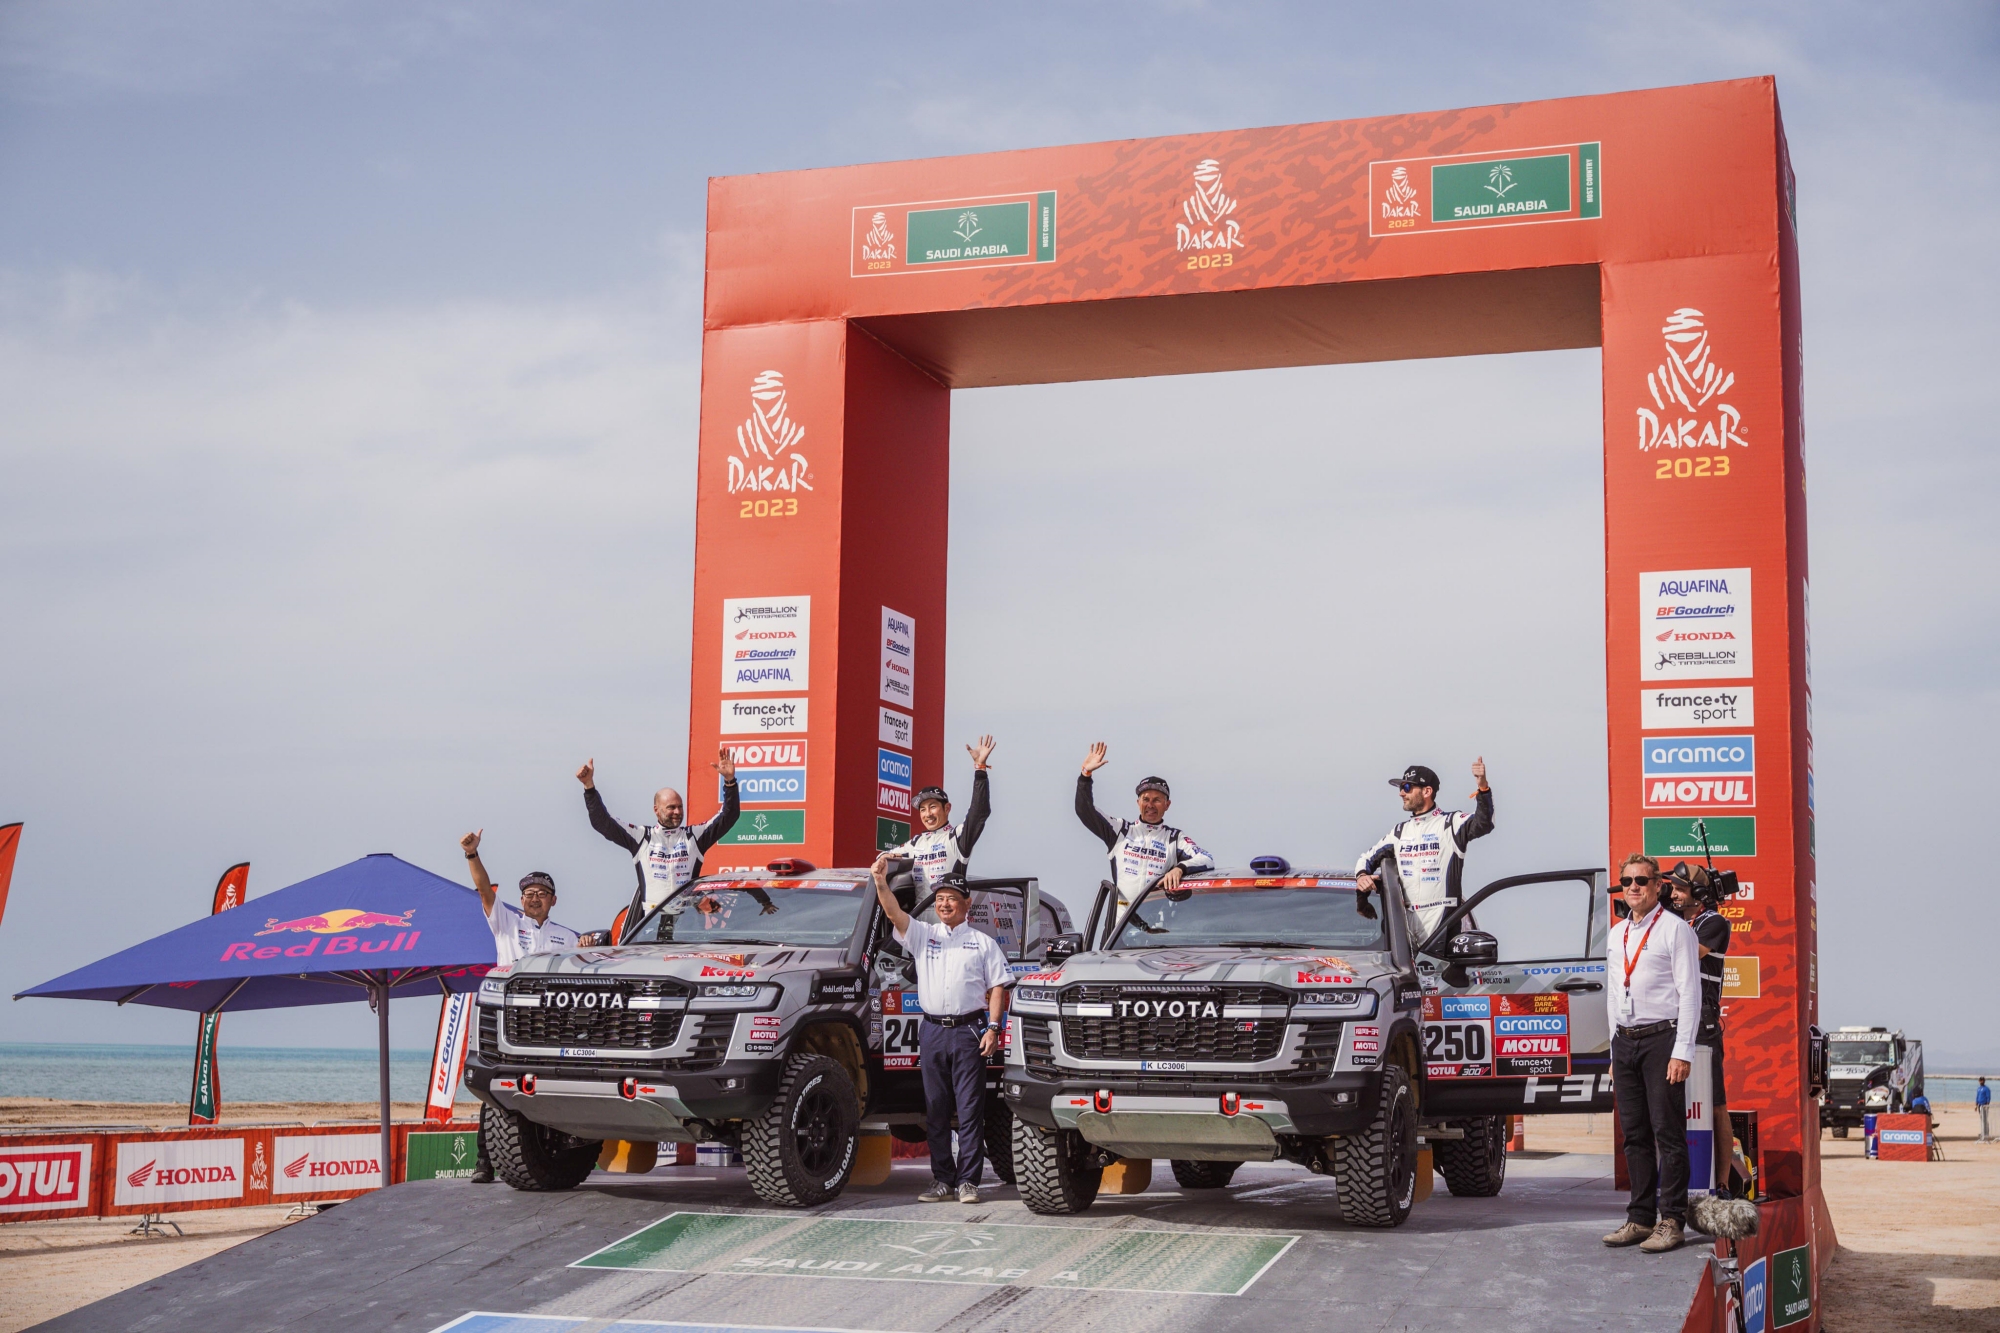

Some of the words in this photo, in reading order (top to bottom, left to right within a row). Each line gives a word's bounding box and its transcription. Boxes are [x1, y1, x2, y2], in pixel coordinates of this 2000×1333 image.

[1382, 200, 1421, 219] DAKAR
[1454, 204, 1493, 217] SAUDI
[1497, 200, 1548, 213] ARABIA
[1388, 219, 1415, 228] 2023
[1176, 220, 1244, 252] DAKAR
[862, 243, 897, 260] DAKAR
[926, 248, 961, 260] SAUDI
[965, 244, 1008, 256] ARABIA
[867, 261, 891, 269] 2023
[1187, 253, 1233, 269] 2023
[1637, 404, 1748, 452] DAKAR
[727, 453, 813, 494] DAKAR
[1656, 456, 1730, 479] 2023
[740, 498, 798, 518] 2023
[1659, 579, 1728, 597] AQUAFINA
[745, 606, 797, 615] REBELLION
[1657, 604, 1735, 616] BFGoodrich
[749, 631, 796, 639] HONDA
[887, 617, 909, 638] AQUAFINA
[1674, 631, 1736, 641] HONDA
[735, 649, 796, 658] BFGoodrich
[886, 639, 910, 654] BFGoodrich
[1669, 651, 1735, 660] REBELLION
[736, 668, 791, 683] AQUAFINA
[891, 663, 910, 676] HONDA
[760, 715, 794, 730] sport
[1693, 707, 1736, 724] sport
[895, 729, 908, 742] sport
[1651, 746, 1745, 763] aramco
[881, 759, 909, 778] aramco
[738, 778, 799, 793] ramco
[1650, 781, 1748, 802] MOTUL
[880, 787, 909, 811] MOTUL
[1670, 845, 1695, 853] SAUDI
[1718, 907, 1745, 918] 023
[1731, 921, 1752, 932] udi
[220, 937, 322, 962] Red
[322, 931, 421, 955] Bull
[1522, 967, 1564, 975] TOYO
[1564, 966, 1606, 974] TIRES
[545, 992, 624, 1009] TOYOTA
[1445, 1003, 1487, 1012] aramco
[1119, 1001, 1218, 1017] TOYOTA
[1499, 1019, 1562, 1031] aramco
[751, 1031, 777, 1039] MOTUL
[1426, 1024, 1486, 1061] 250
[437, 993, 463, 1093] BFGoodri
[1355, 1042, 1377, 1050] MOTUL
[1502, 1039, 1561, 1053] MOTUL
[884, 1058, 913, 1066] MOTUL
[1157, 1062, 1185, 1070] LC3006
[1462, 1067, 1490, 1075] 300V
[1529, 1066, 1552, 1075] sport
[802, 1074, 823, 1098] TIRES
[1883, 1132, 1921, 1142] aramco
[309, 1159, 381, 1177] HONDA
[435, 1169, 455, 1179] SAUDI
[0, 1159, 74, 1199] OTUL
[155, 1166, 236, 1186] HONDA
[250, 1174, 268, 1190] DAKAR
[733, 1257, 883, 1272] SAUDI
[887, 1264, 1078, 1281] ARABA
[1785, 1304, 1797, 1316] SAUDI
